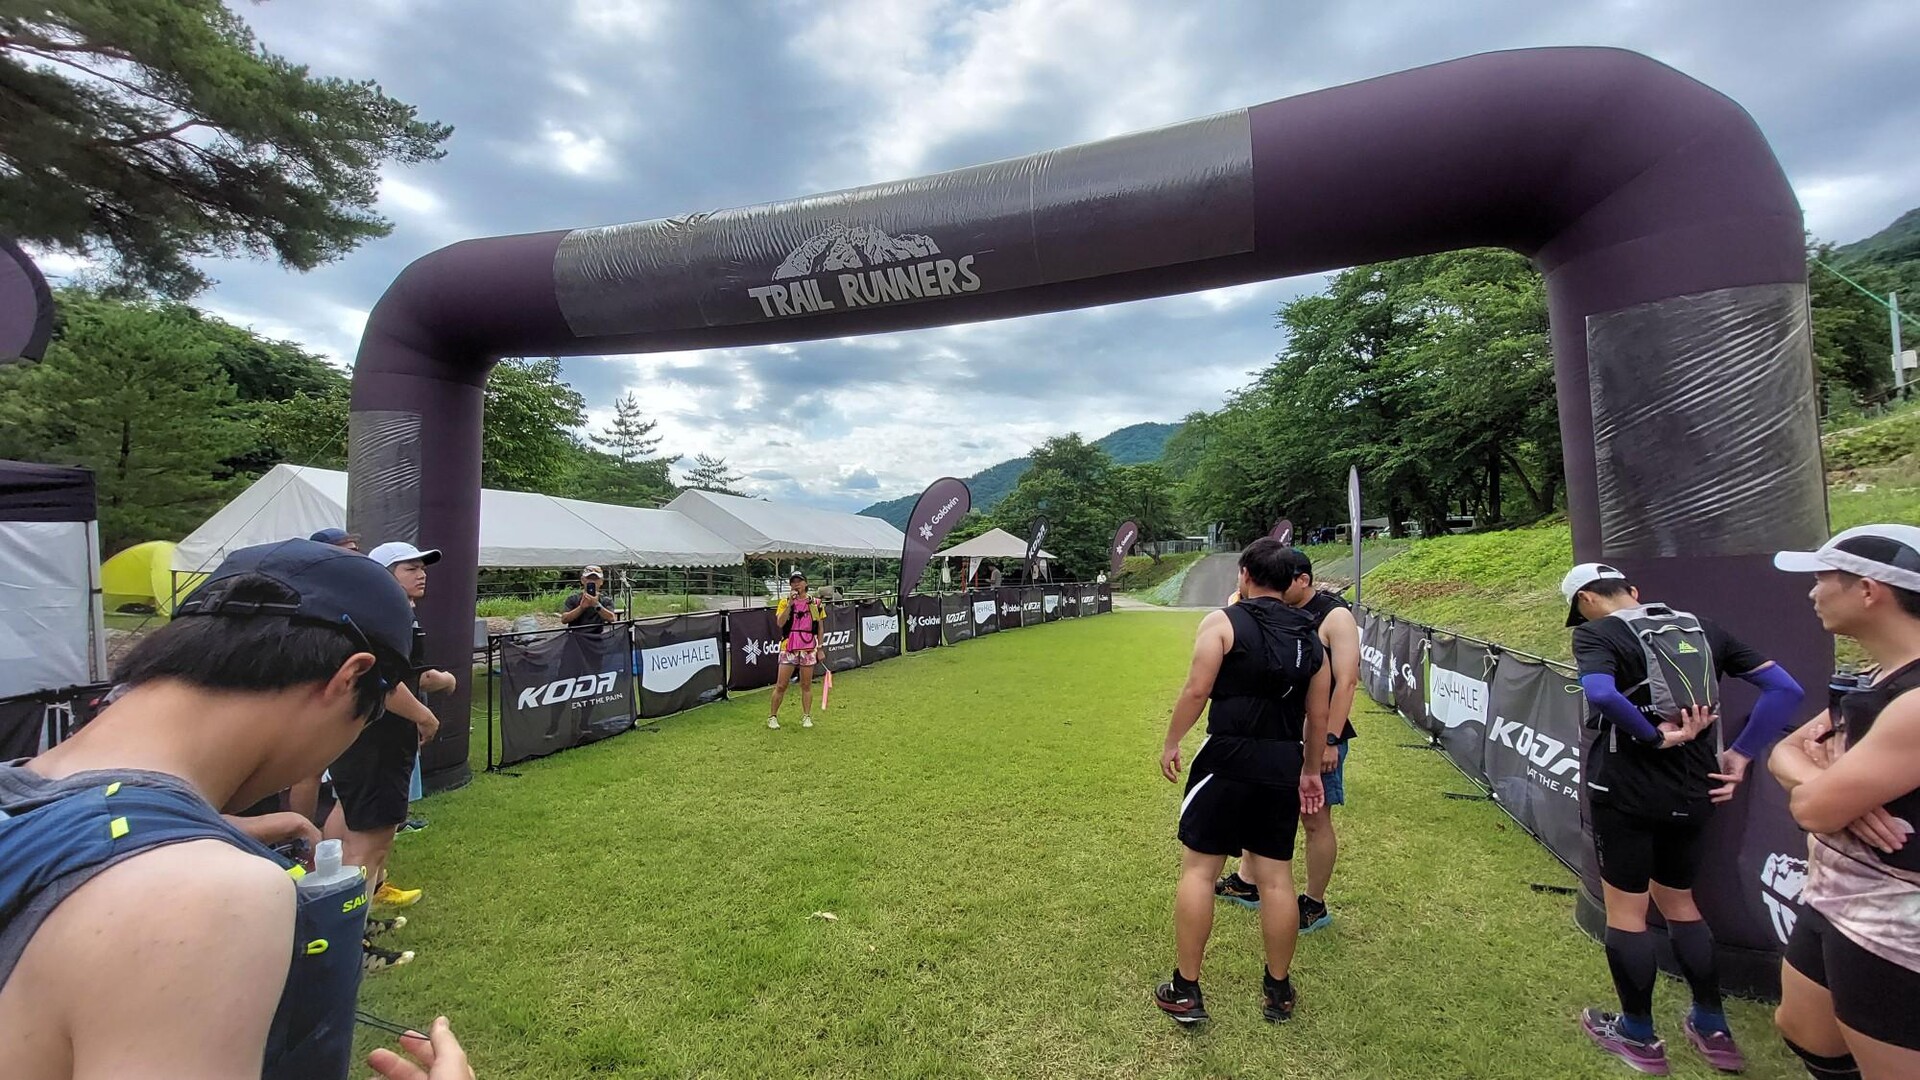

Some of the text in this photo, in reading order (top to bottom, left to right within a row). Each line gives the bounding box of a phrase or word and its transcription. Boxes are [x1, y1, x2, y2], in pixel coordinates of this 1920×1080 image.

[748, 255, 981, 318] TRAIL RUNNERS
[931, 496, 959, 525] Goldwin
[763, 640, 781, 655] Gold
[823, 631, 850, 646] ODA
[651, 645, 711, 672] New-HALE
[518, 671, 618, 710] KODA
[571, 700, 588, 709] EAT
[605, 693, 623, 703] PAIN
[1539, 773, 1560, 792] THE
[1563, 786, 1580, 801] PA
